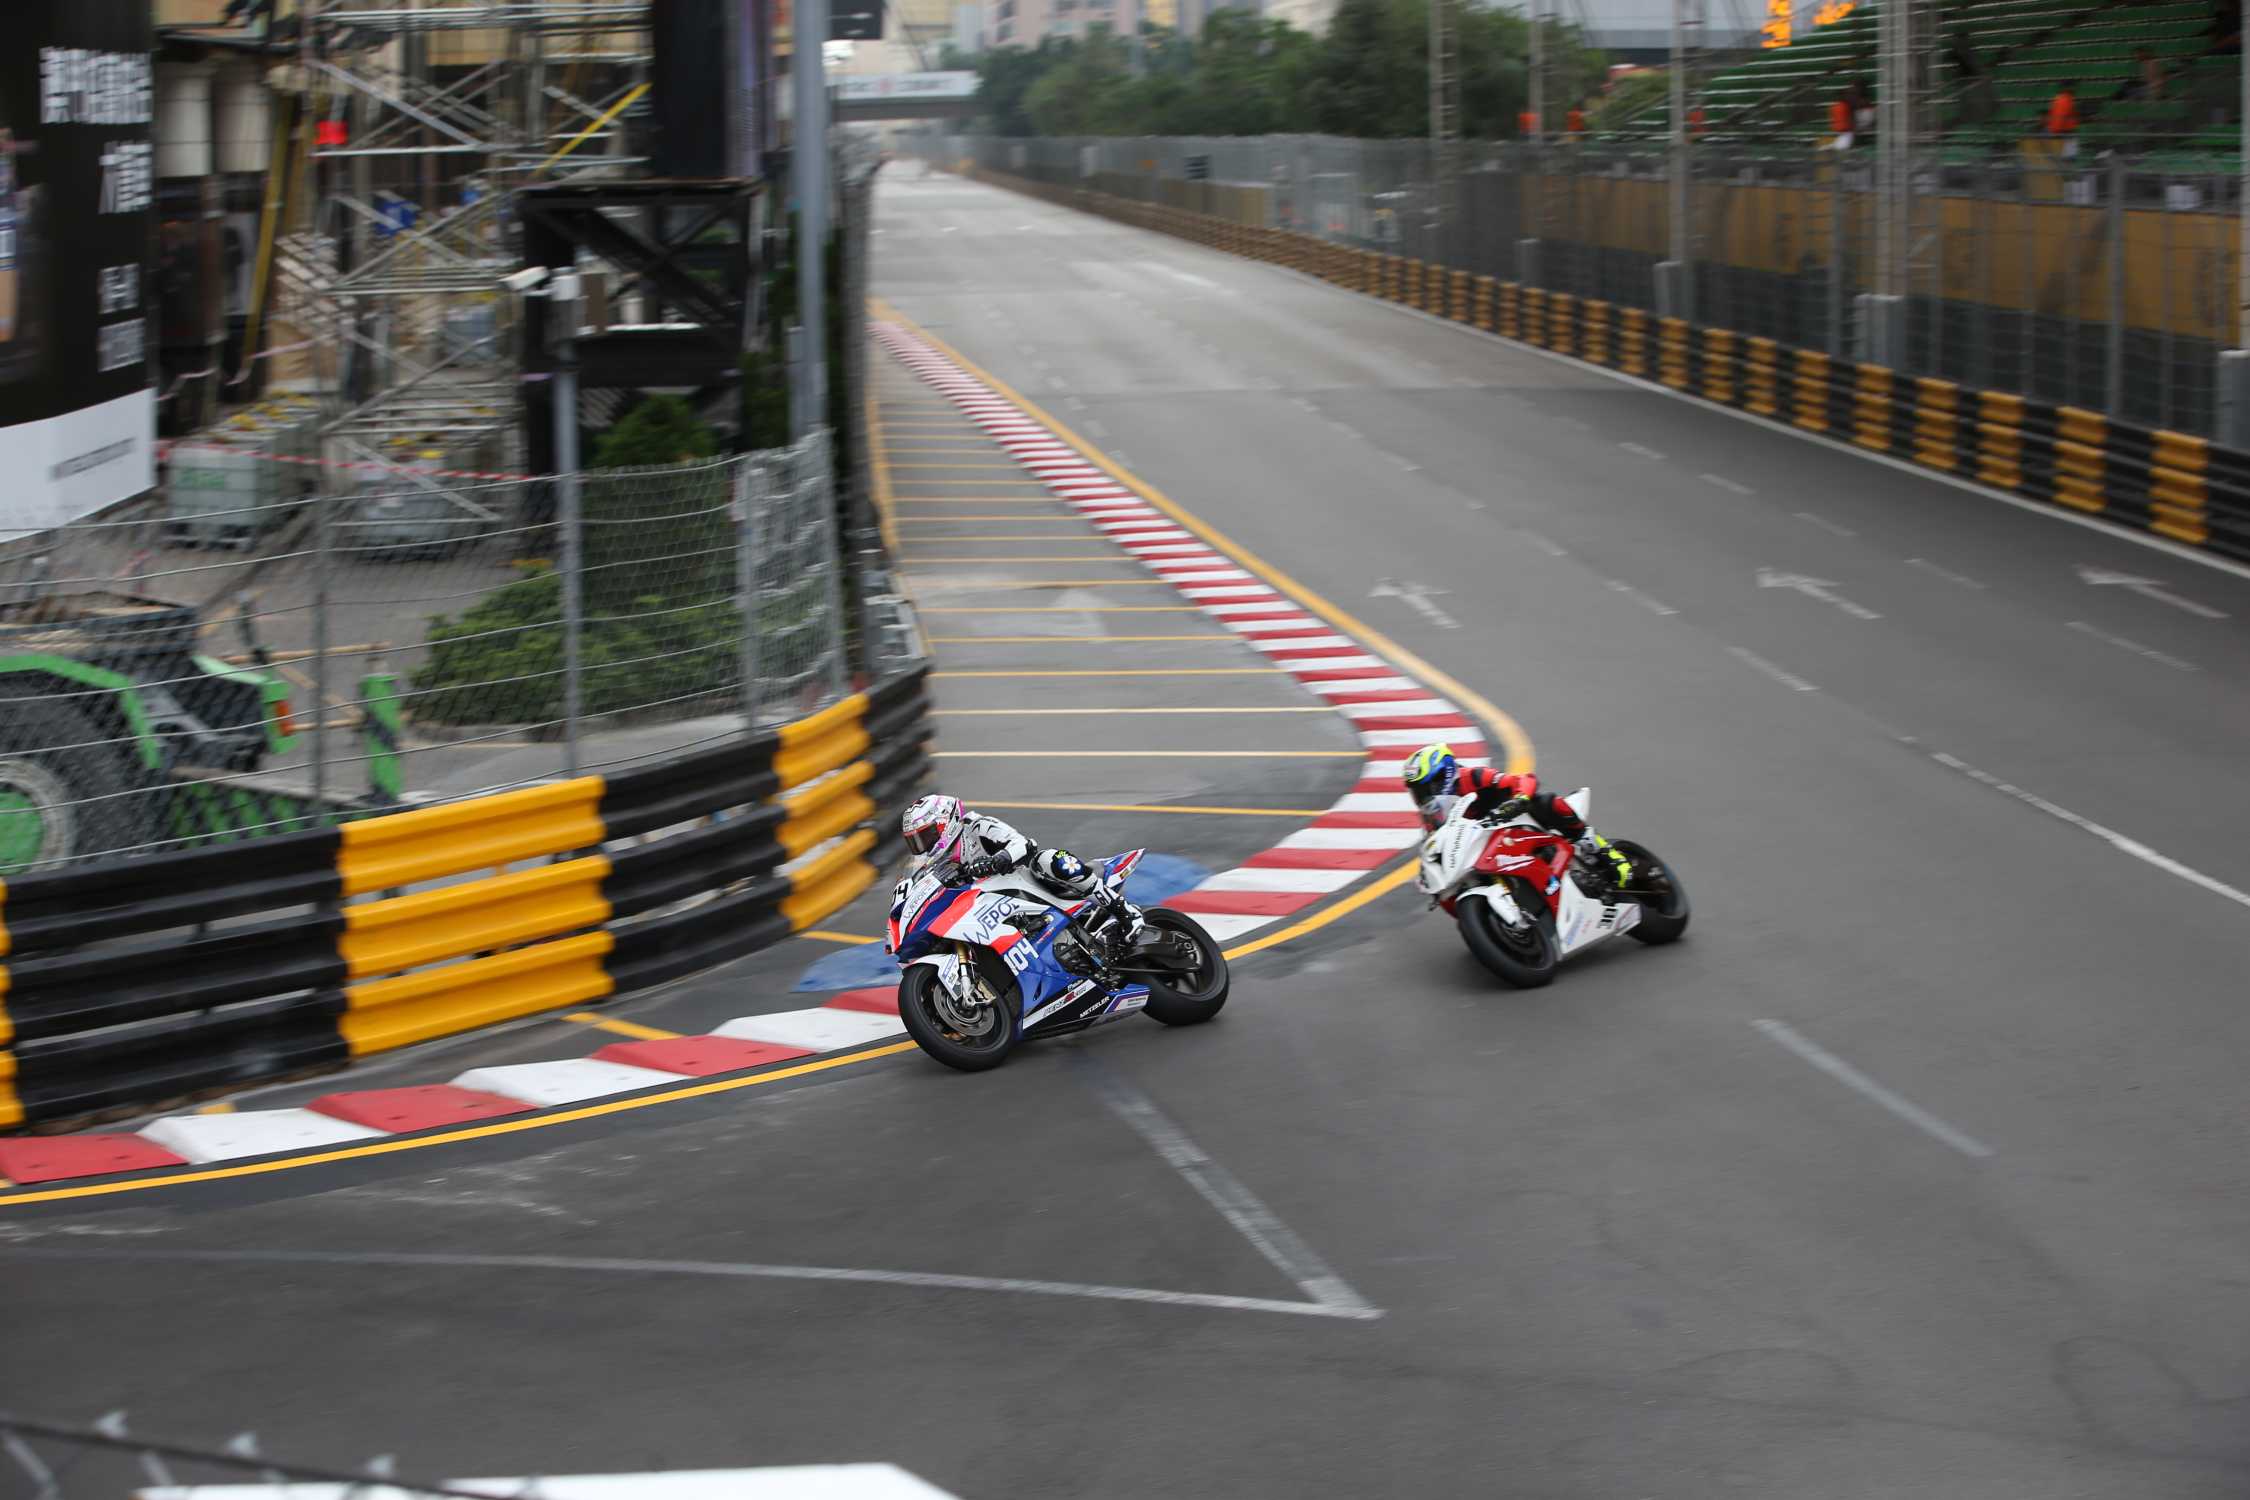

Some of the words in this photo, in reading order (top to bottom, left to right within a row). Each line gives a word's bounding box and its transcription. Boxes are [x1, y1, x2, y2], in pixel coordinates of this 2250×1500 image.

[963, 901, 1019, 944] WEPOL
[1003, 938, 1039, 977] 104
[1080, 996, 1110, 1018] METZELER
